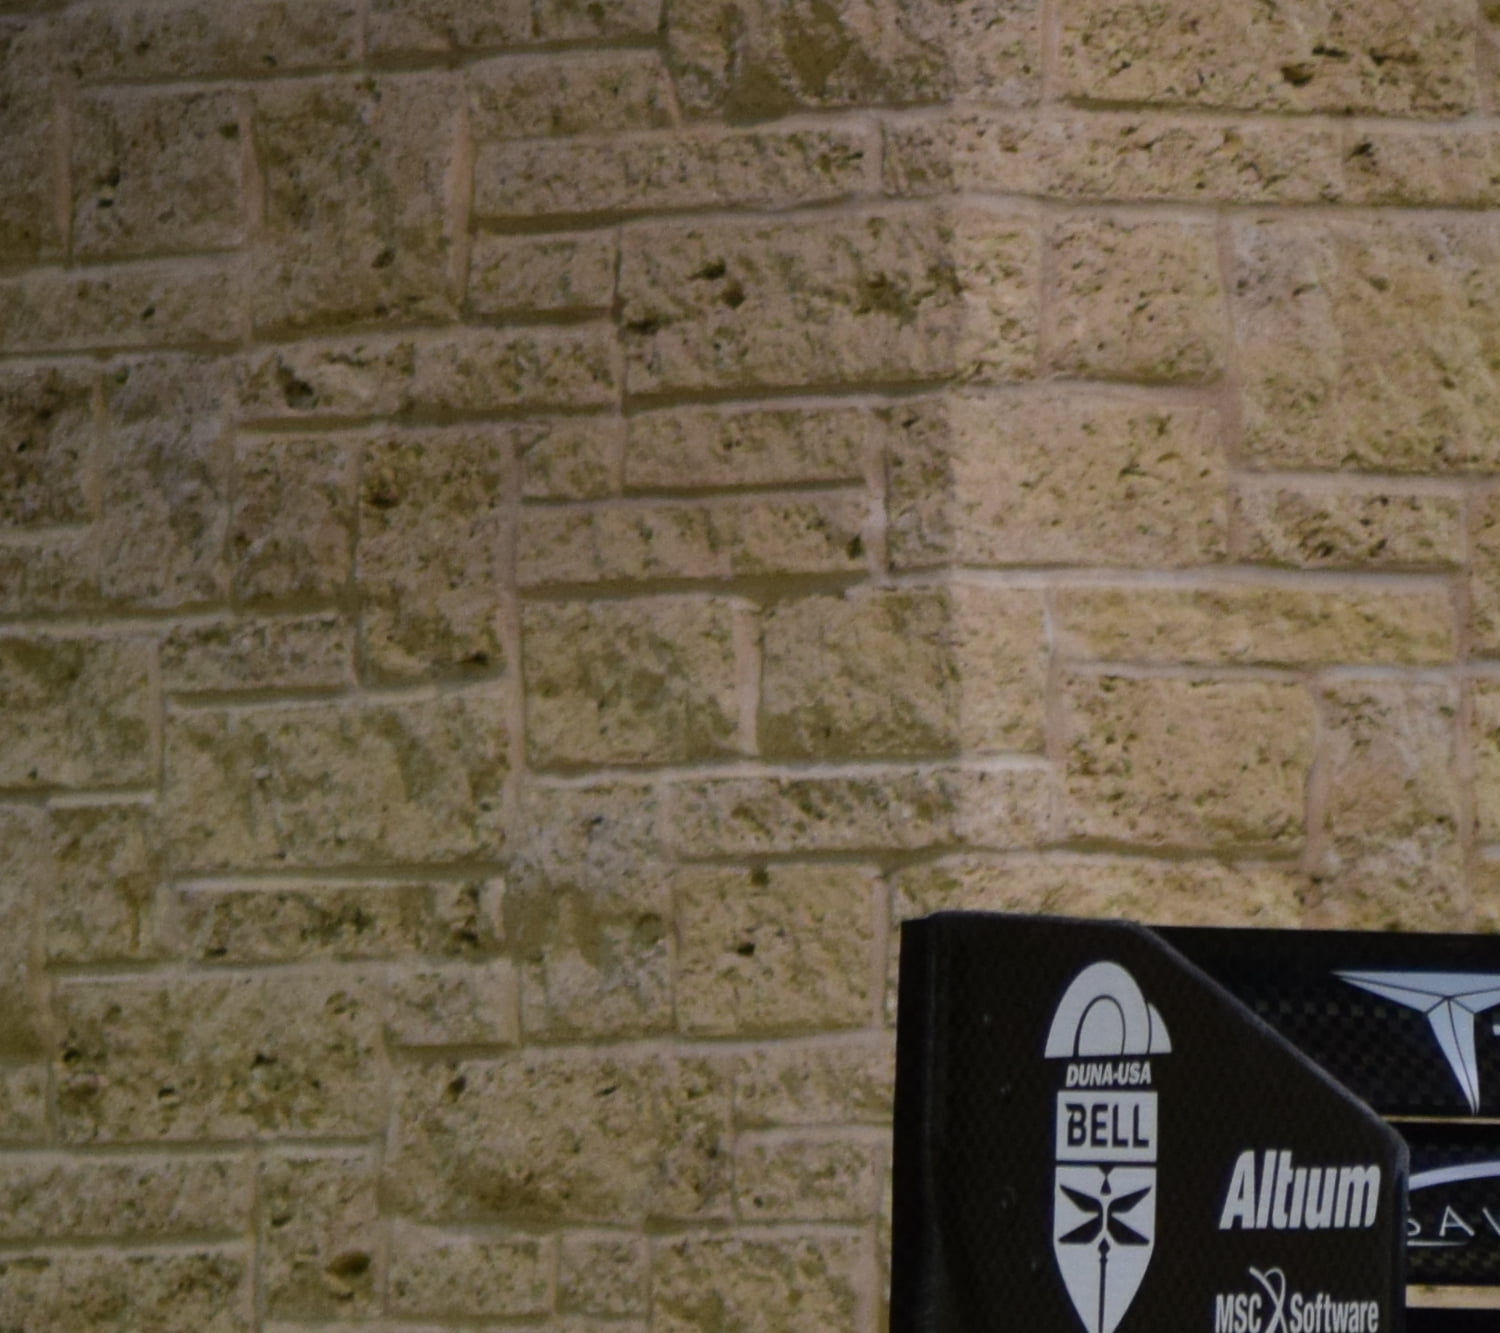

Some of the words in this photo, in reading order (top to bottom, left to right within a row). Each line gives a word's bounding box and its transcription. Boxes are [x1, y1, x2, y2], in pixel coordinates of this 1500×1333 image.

[1065, 1061, 1152, 1087] DUNA-USA
[1065, 1103, 1149, 1148] BELL
[1218, 1150, 1381, 1229] Altium
